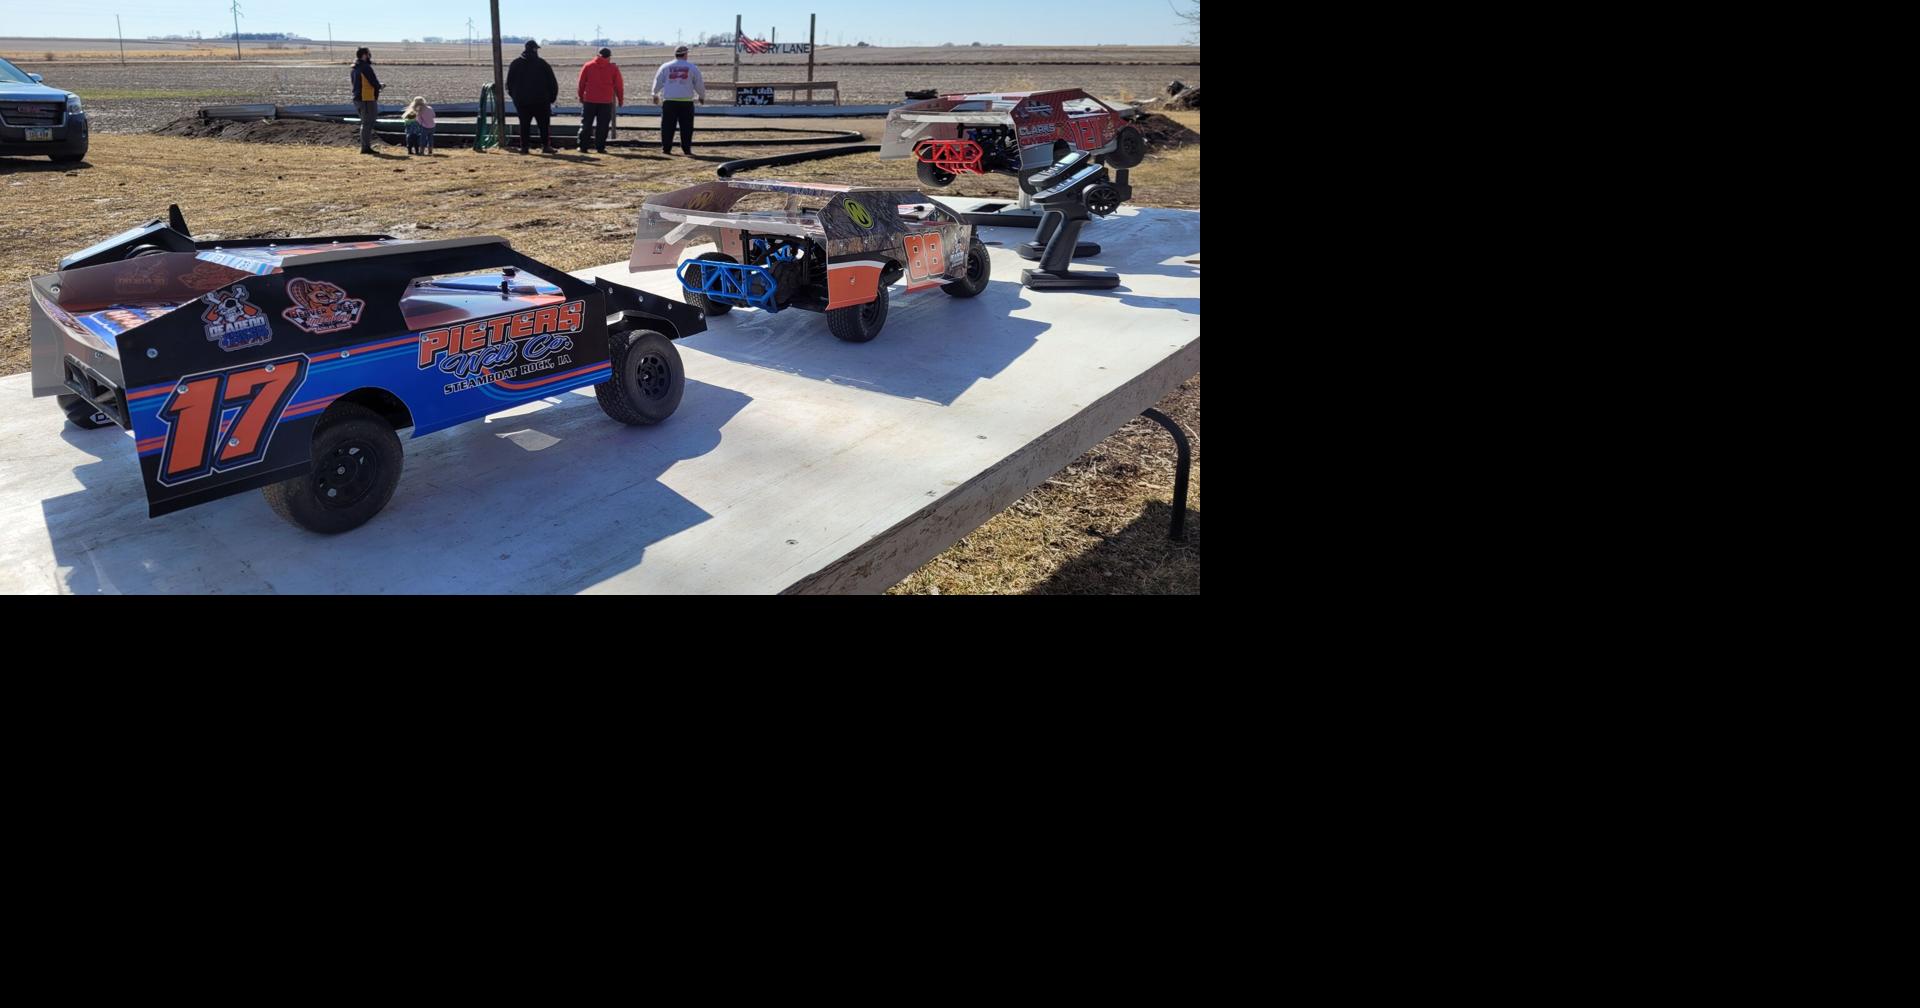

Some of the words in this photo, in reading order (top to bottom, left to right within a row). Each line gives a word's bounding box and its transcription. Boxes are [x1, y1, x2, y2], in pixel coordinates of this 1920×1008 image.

[736, 43, 781, 54] VCORY
[783, 43, 811, 54] LANE
[903, 230, 945, 280] 88
[208, 316, 266, 338] DEADEND
[418, 300, 585, 370] PIETERS
[440, 341, 518, 378] Well
[522, 333, 573, 361] Co.
[443, 367, 518, 395] STEAMBOAT
[520, 358, 555, 374] ROCK,
[557, 353, 572, 365] IA
[159, 356, 308, 484] 17
